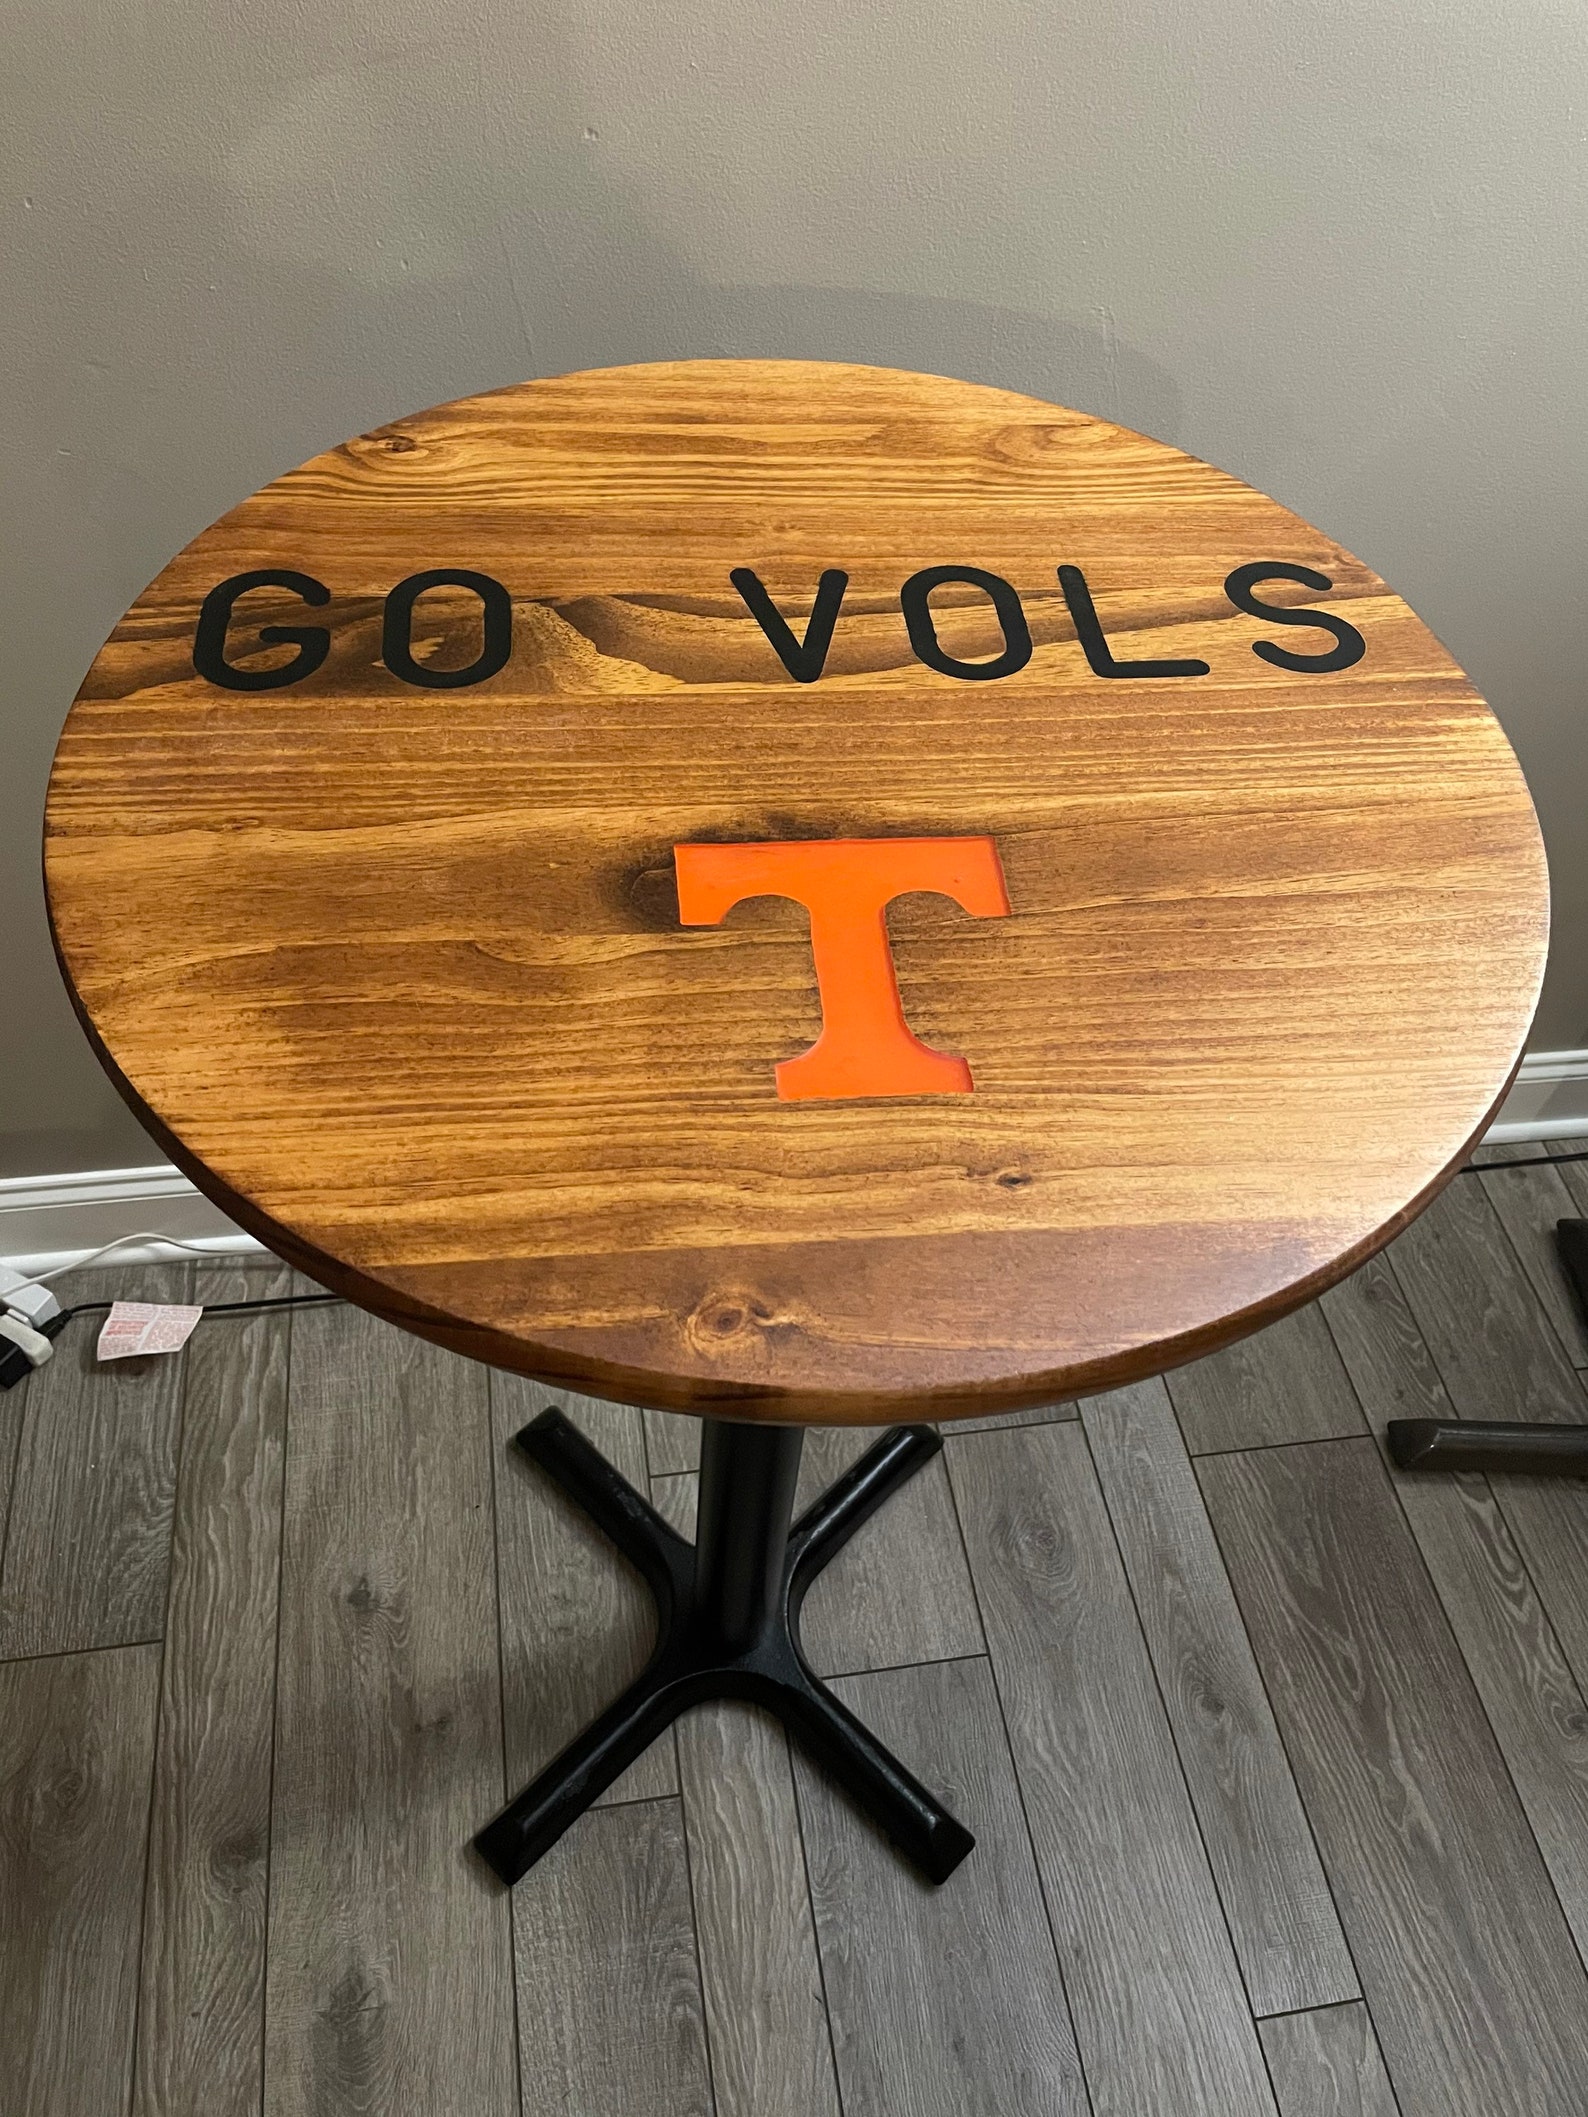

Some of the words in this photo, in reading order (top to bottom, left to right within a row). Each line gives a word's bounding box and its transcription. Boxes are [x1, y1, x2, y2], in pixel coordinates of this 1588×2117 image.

[192, 568, 512, 690] GO
[730, 562, 1366, 683] VOLS
[673, 837, 1010, 1101] T
